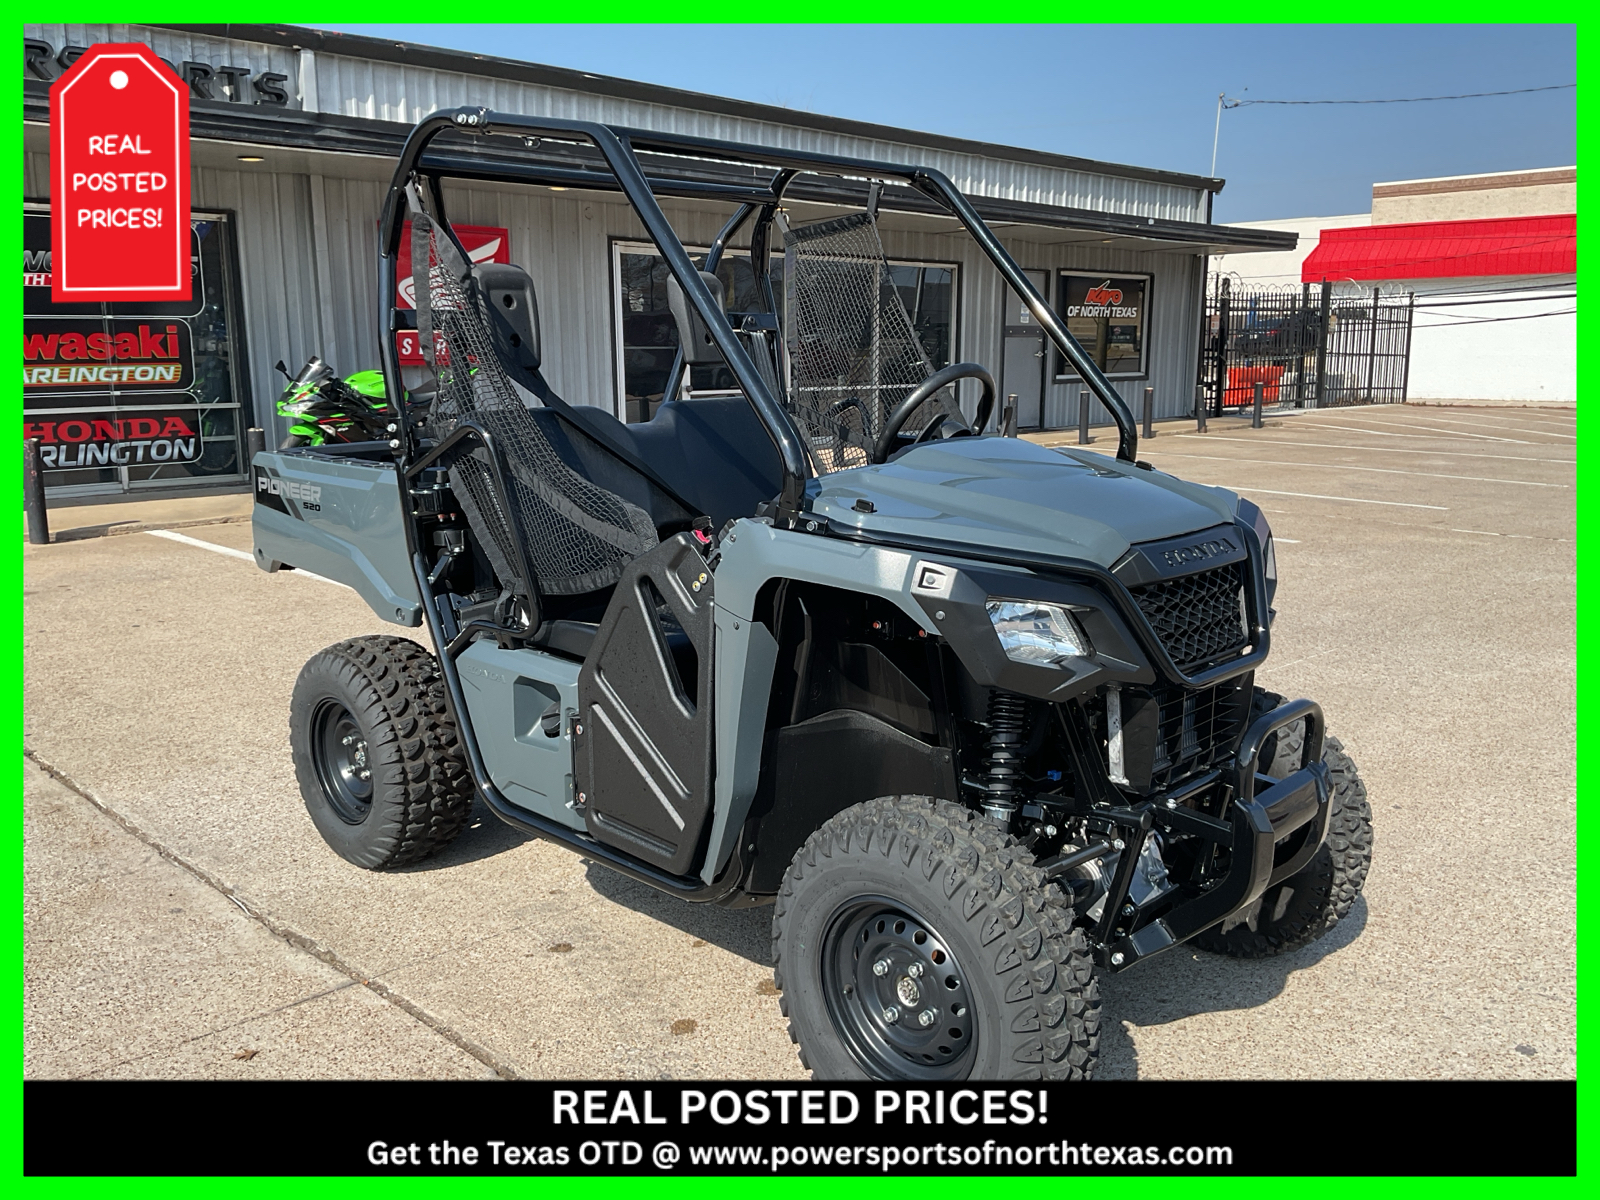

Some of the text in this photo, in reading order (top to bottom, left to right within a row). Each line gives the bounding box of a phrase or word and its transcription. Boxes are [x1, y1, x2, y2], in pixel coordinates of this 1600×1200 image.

[1067, 306, 1138, 318] OF NORTH TEXAS
[23, 417, 196, 444] HONDA
[257, 476, 322, 502] PIONEER
[302, 501, 322, 512] 520
[1161, 538, 1239, 567] HONDA
